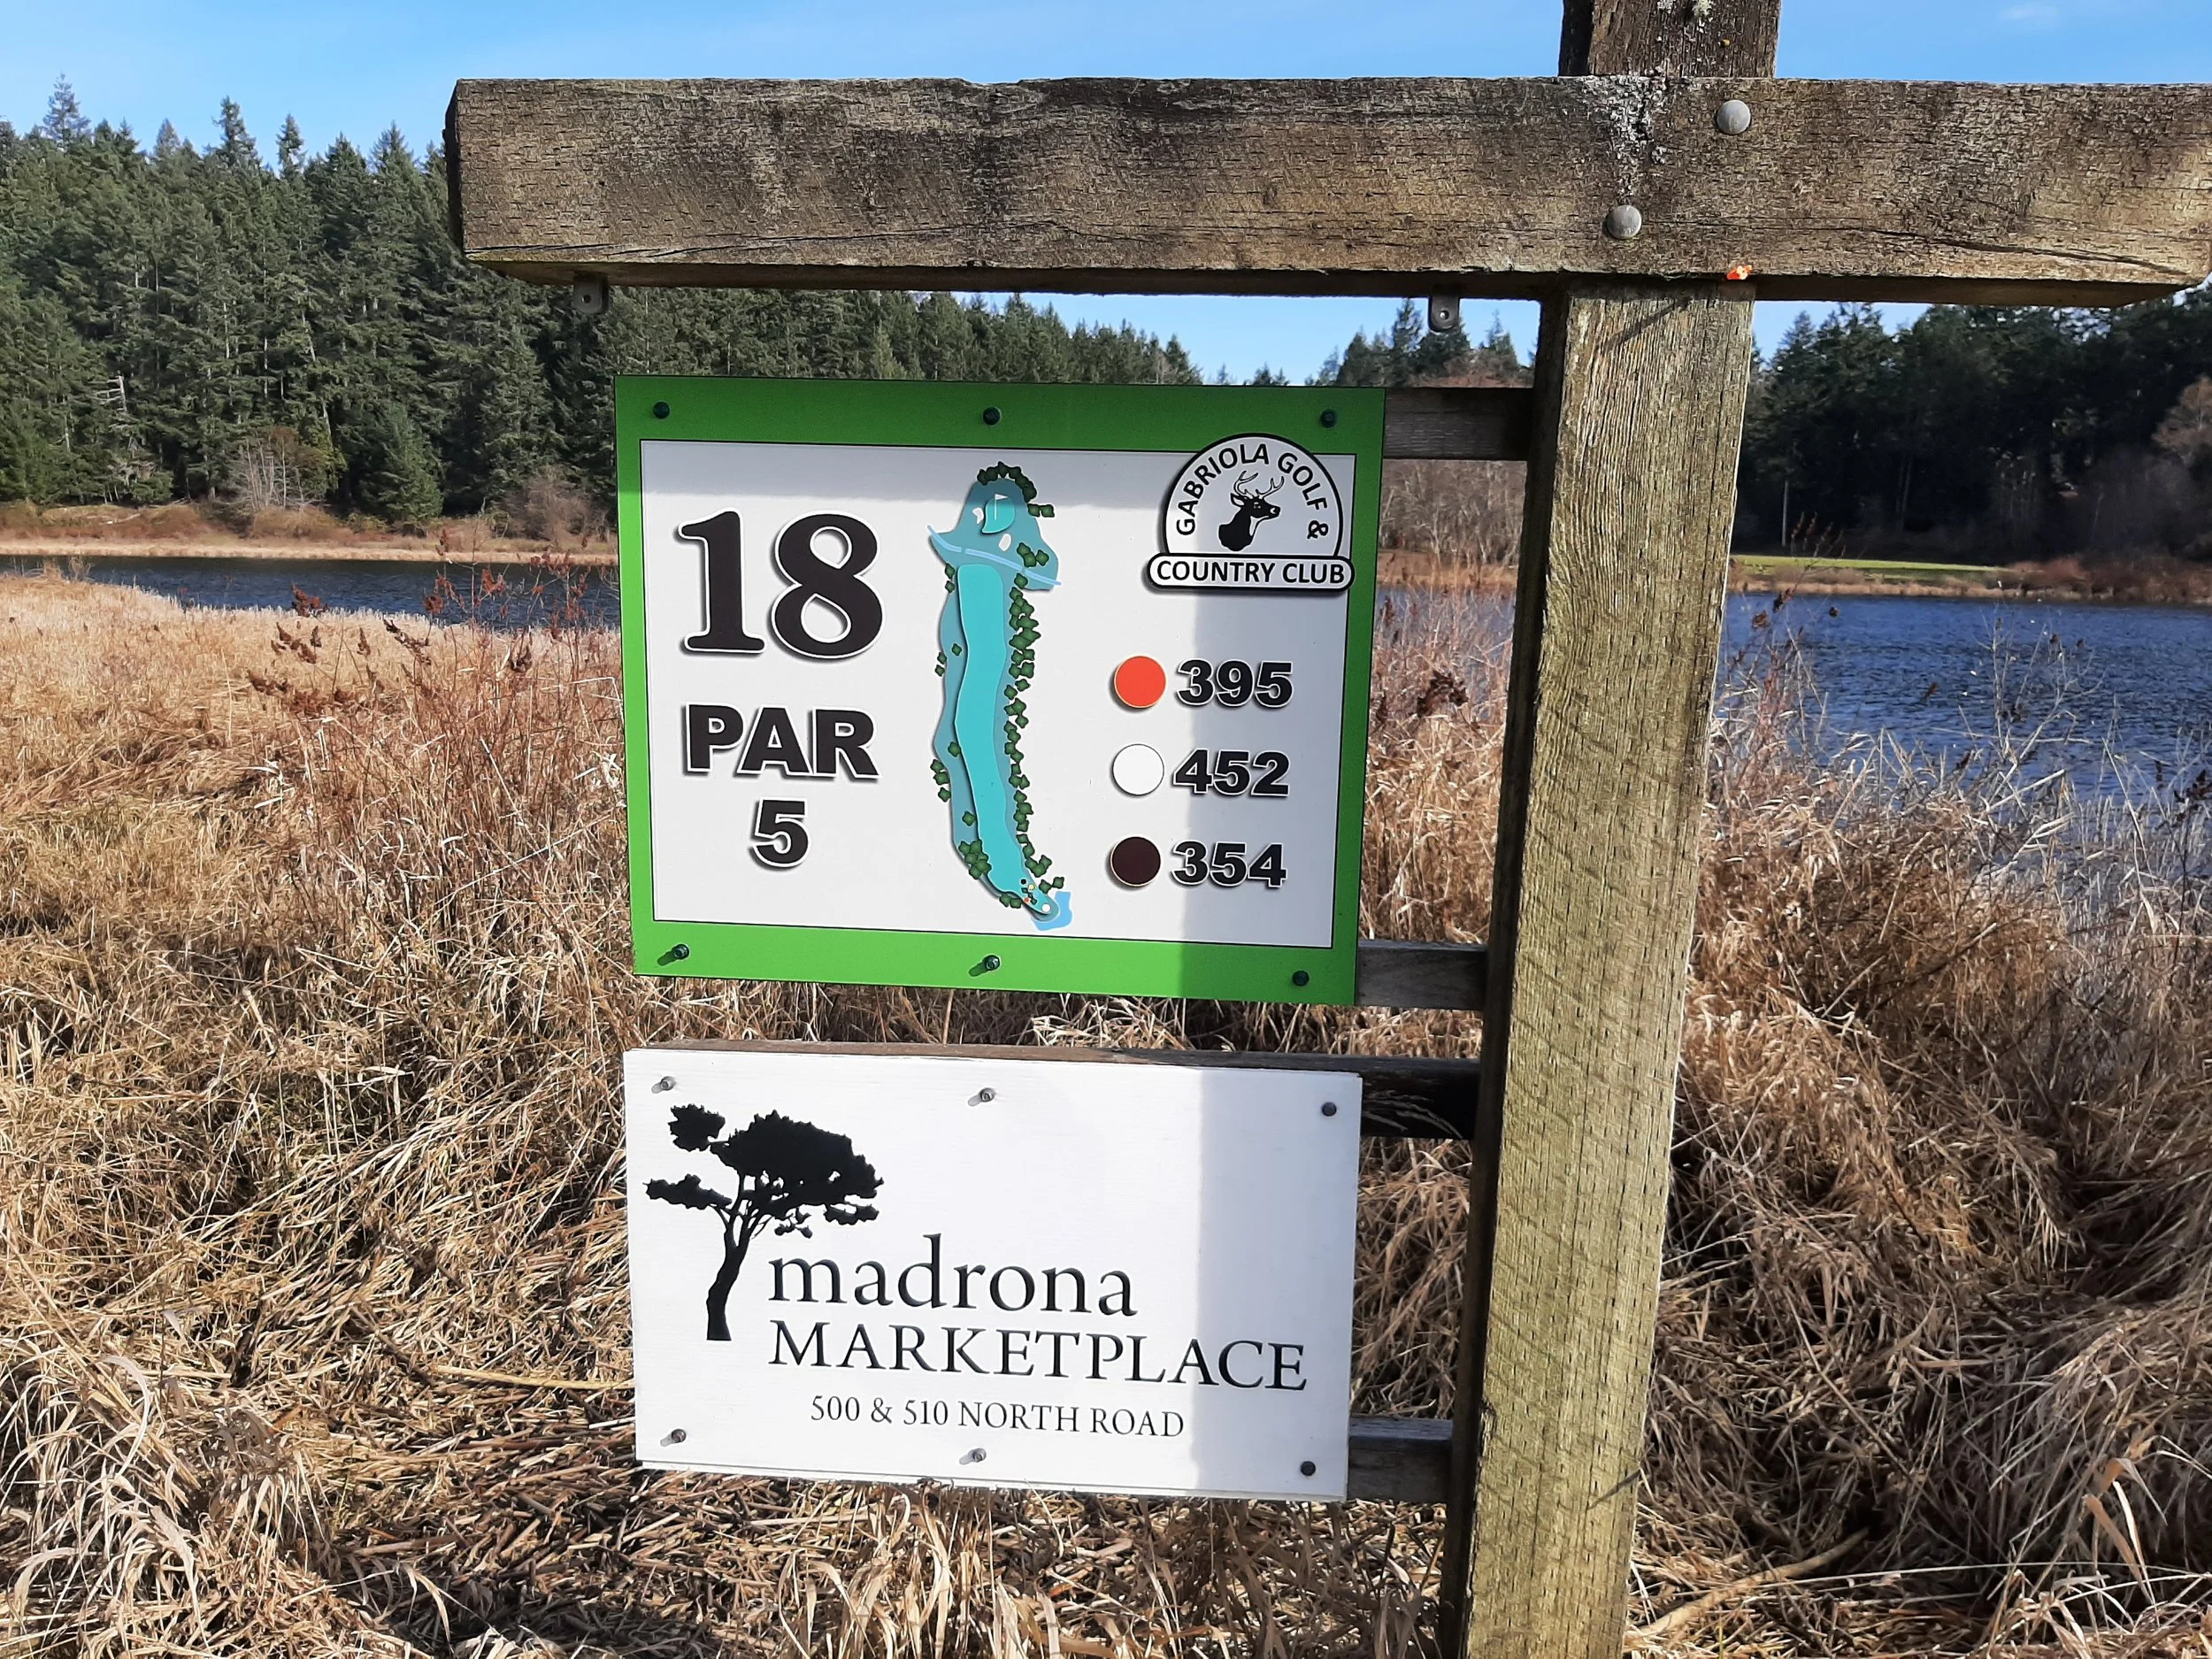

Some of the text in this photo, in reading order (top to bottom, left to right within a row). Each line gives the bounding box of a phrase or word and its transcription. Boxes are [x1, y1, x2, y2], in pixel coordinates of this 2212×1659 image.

[1176, 443, 1329, 539] GABRIOLA GOLF &
[677, 510, 883, 659] 18
[1156, 560, 1345, 584] COUNTRY CLUB
[1176, 659, 1294, 707] 395
[685, 704, 879, 779] PAR
[1173, 751, 1291, 796] 452
[753, 800, 809, 867] 5
[1173, 841, 1286, 887] 354
[768, 1233, 1138, 1317] madrona
[768, 1319, 1308, 1391] MARKETPLACE
[810, 1395, 1185, 1439] 500 & 510 NORTH ROAD
